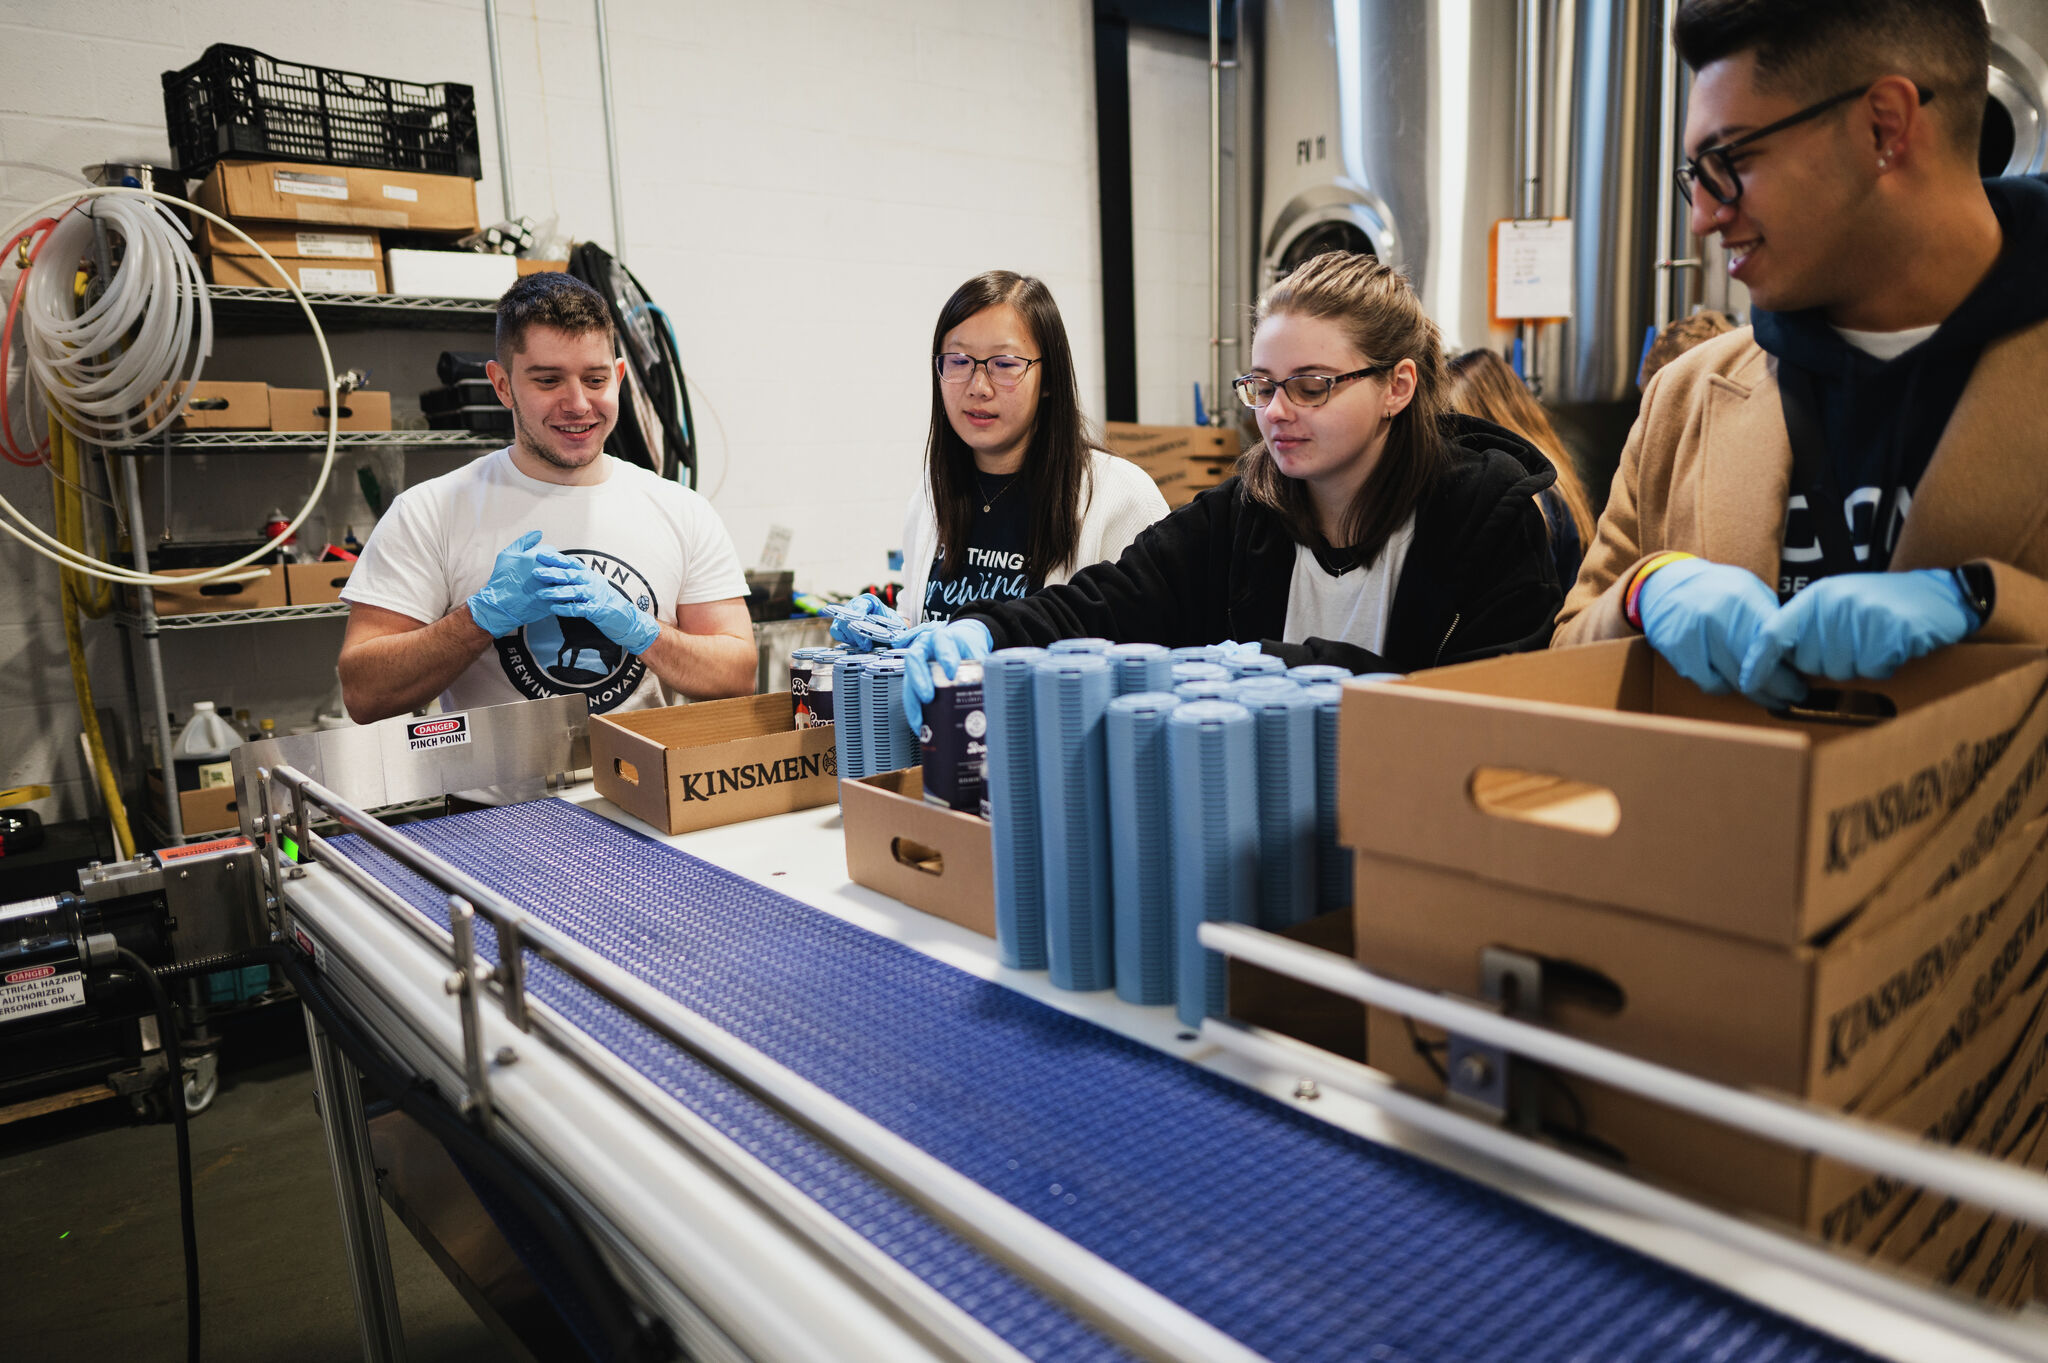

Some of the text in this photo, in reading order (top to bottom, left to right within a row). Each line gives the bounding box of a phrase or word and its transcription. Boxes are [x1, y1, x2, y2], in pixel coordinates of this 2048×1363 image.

[967, 547, 1032, 570] THING
[576, 556, 630, 585] NN
[507, 646, 561, 698] BREWIN
[419, 722, 455, 734] DANGER
[410, 733, 466, 750] PINCH POINT
[680, 753, 821, 802] KINSMEN
[11, 968, 49, 981] DANGER
[41, 974, 81, 988] HAZARD
[2, 987, 64, 1005] AUTHORIZED
[51, 994, 75, 1004] ONLY
